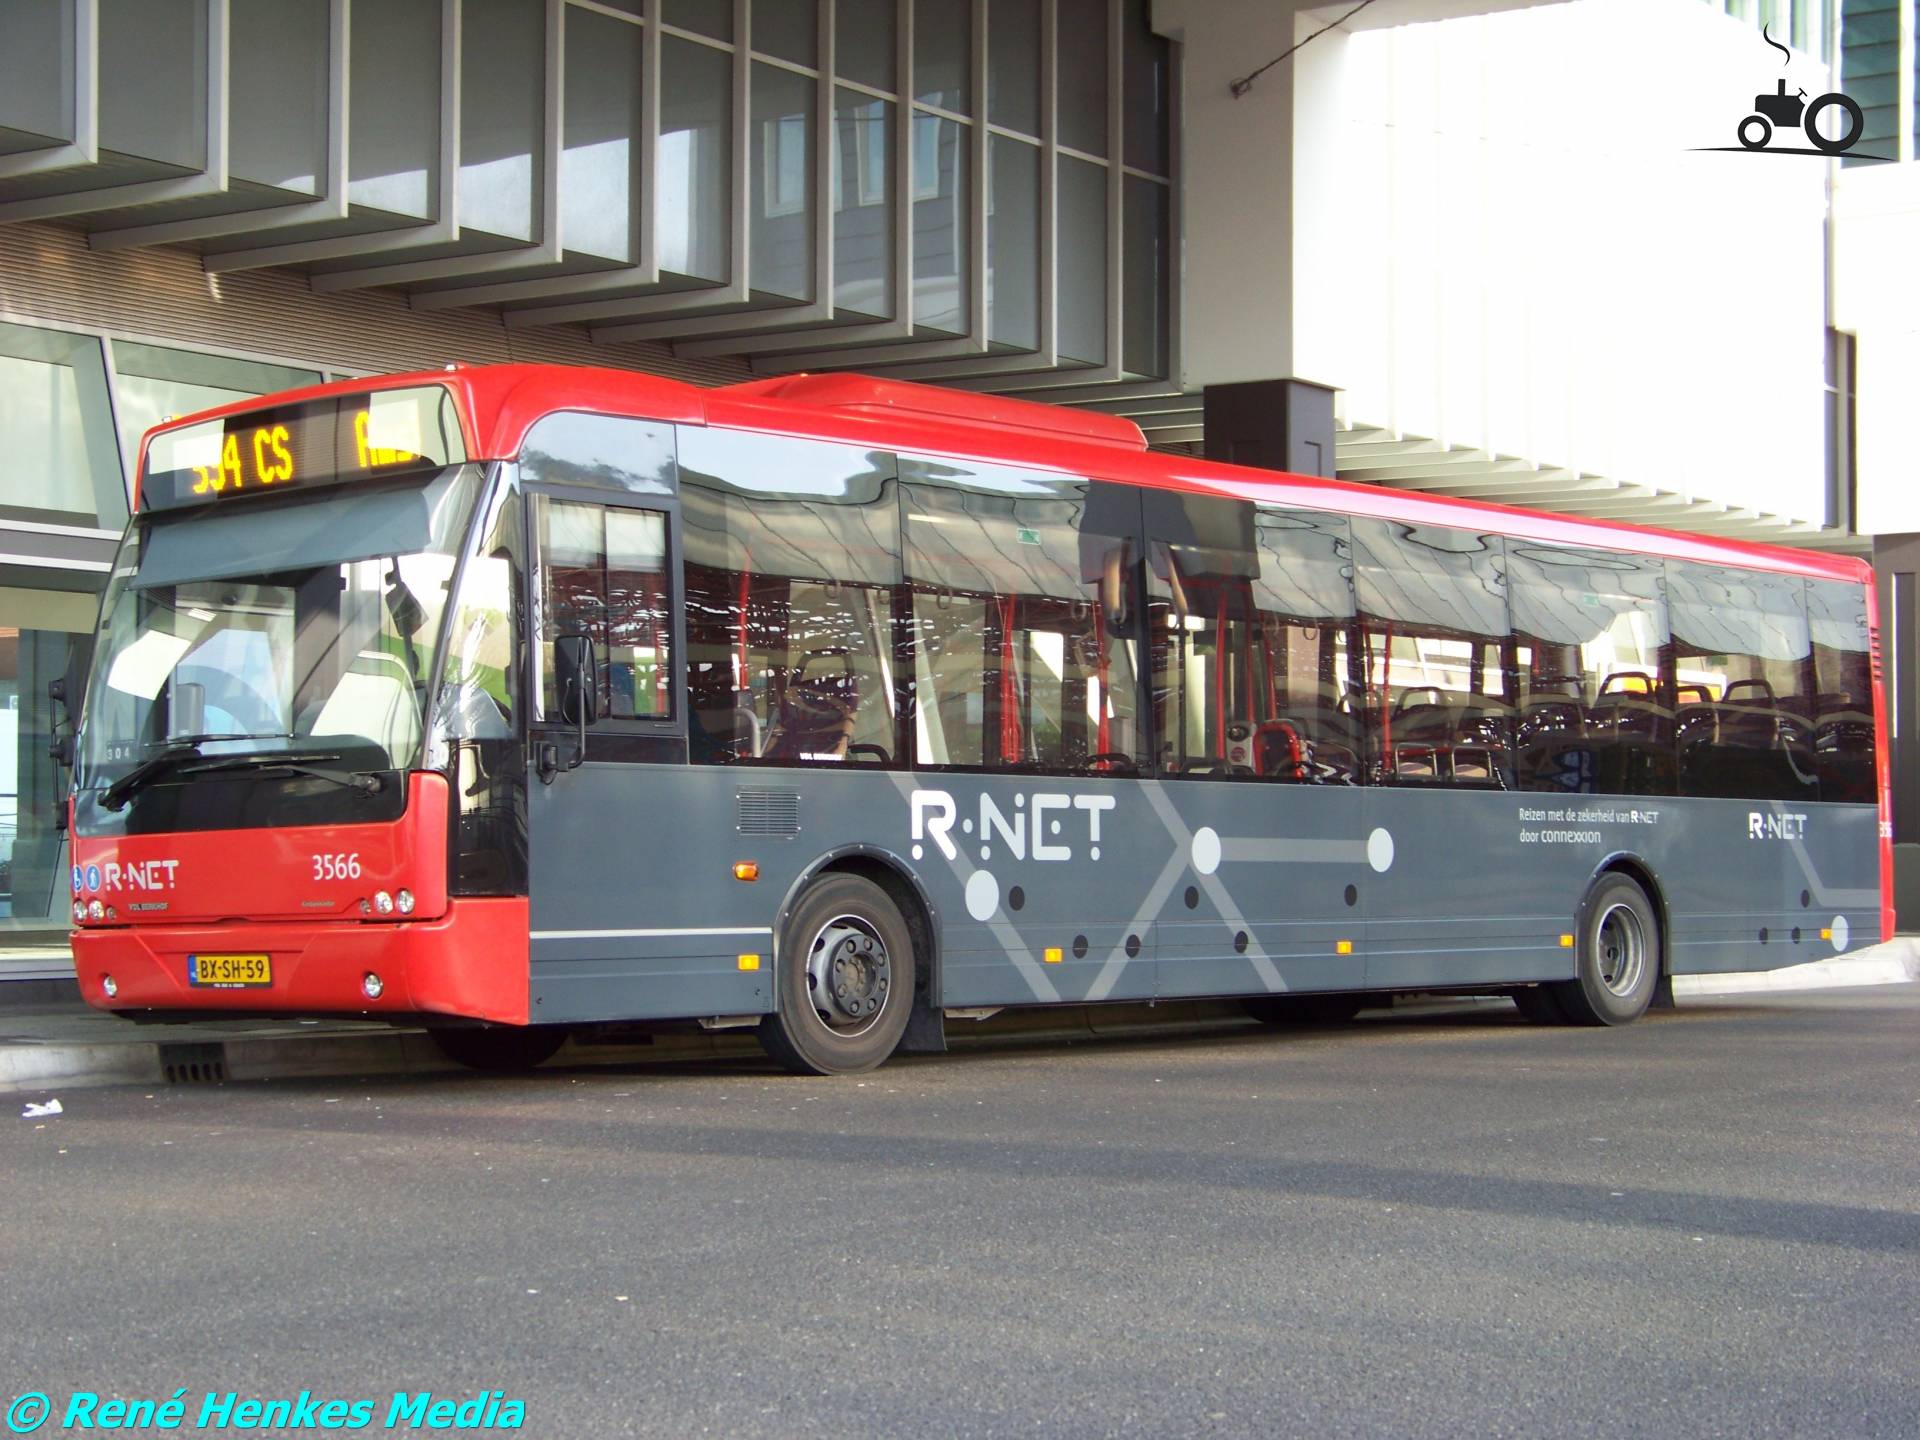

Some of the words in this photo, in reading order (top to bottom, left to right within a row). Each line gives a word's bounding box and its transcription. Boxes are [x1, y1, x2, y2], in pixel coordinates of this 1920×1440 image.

[254, 426, 293, 483] CS
[1519, 808, 1546, 821] Reizen
[1547, 809, 1565, 821] met
[1565, 808, 1576, 821] de
[1577, 808, 1614, 823] zekerheid
[1615, 812, 1630, 823] van
[1519, 828, 1539, 842] door
[1540, 830, 1601, 843] connexxion
[312, 852, 361, 881] 3566
[200, 959, 265, 979] BX-SH-59
